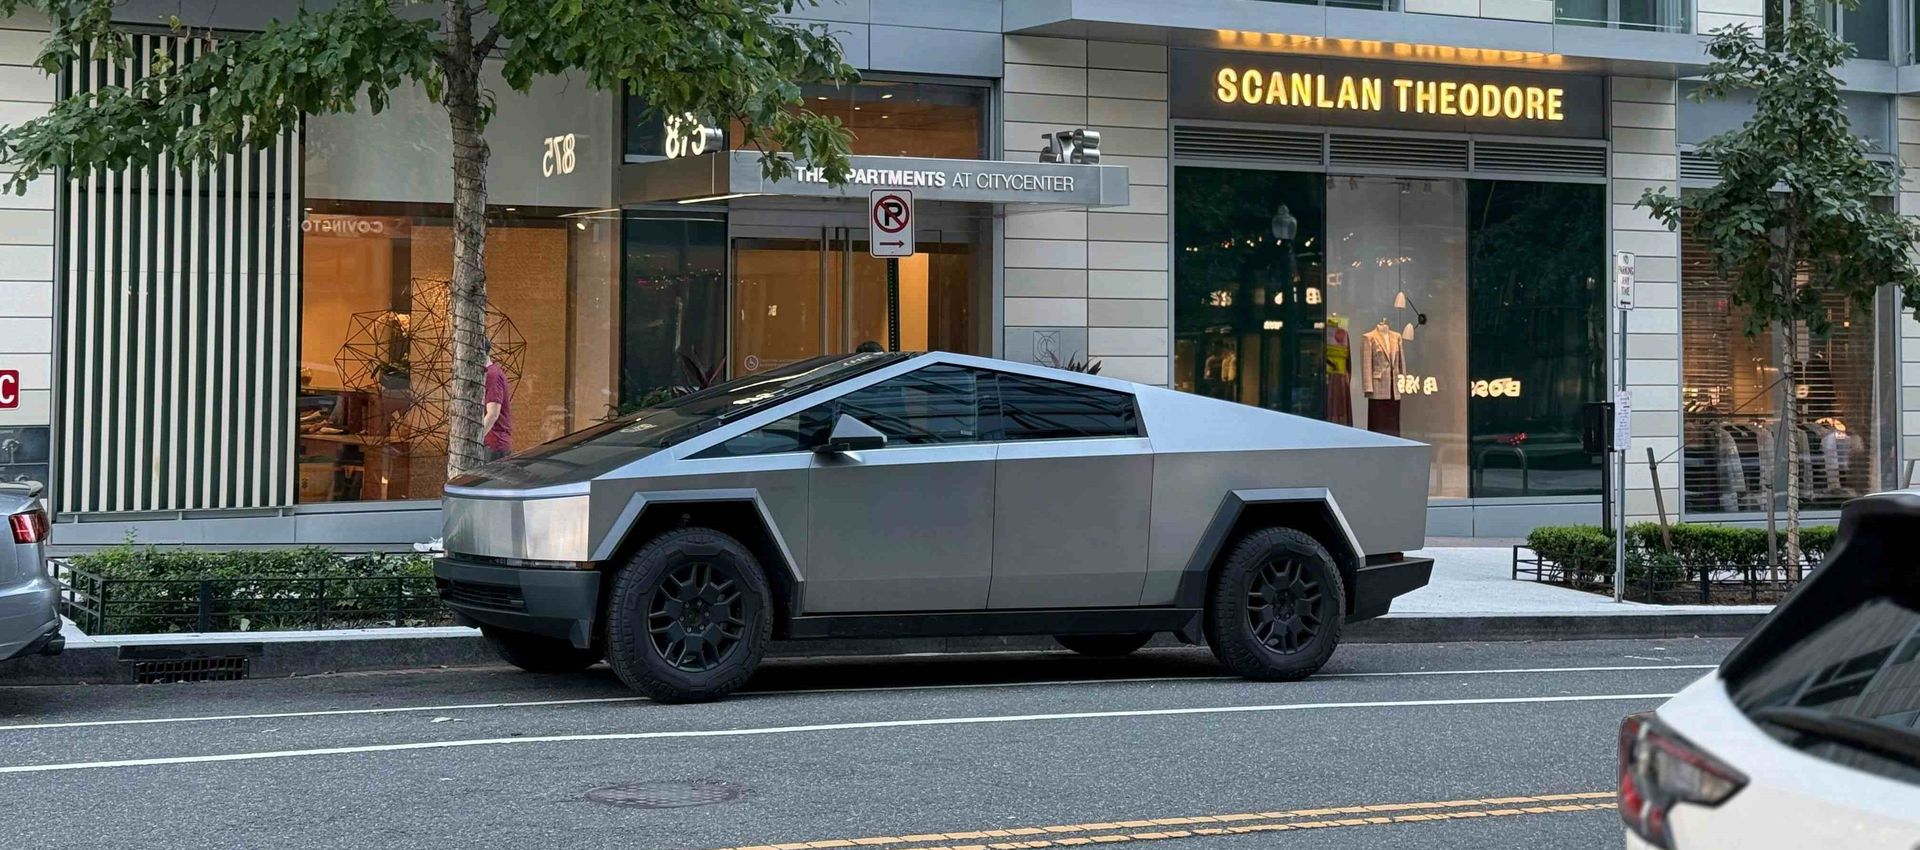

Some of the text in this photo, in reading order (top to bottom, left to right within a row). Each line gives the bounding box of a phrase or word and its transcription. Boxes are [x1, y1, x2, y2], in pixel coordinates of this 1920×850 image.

[1217, 67, 1564, 121] SCANLAN THEODORE
[832, 167, 946, 188] PARTMENTS
[952, 172, 973, 188] AT
[976, 173, 1074, 192] CITYCENTER
